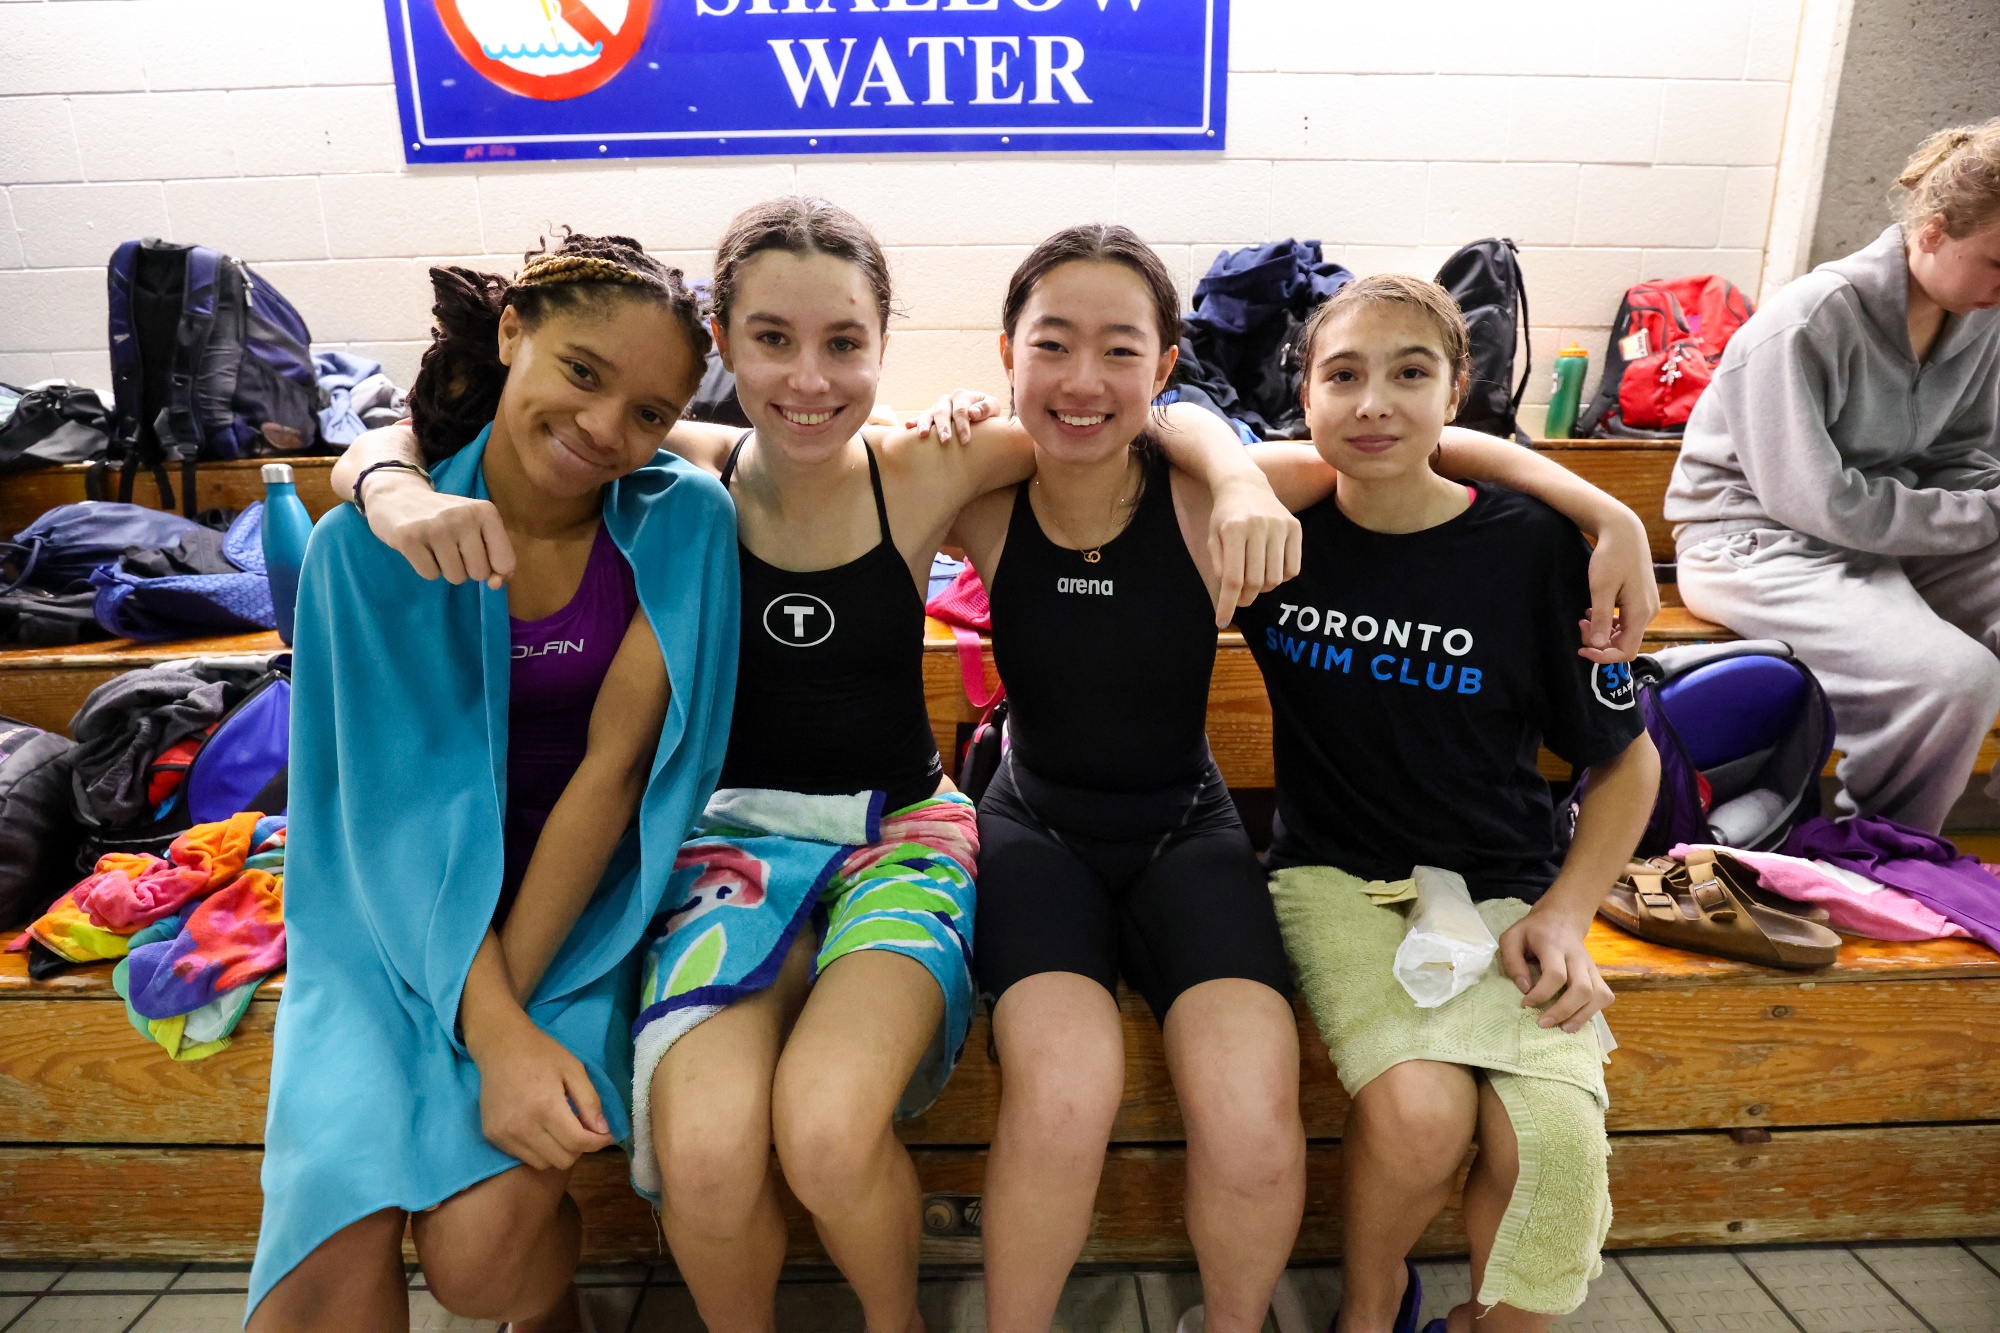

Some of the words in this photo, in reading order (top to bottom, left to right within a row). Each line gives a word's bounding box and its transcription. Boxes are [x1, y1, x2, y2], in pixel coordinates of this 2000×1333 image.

[767, 36, 1094, 109] WATER
[1057, 577, 1114, 596] arena
[783, 605, 815, 638] T
[1278, 602, 1474, 657] TORONTO
[1266, 626, 1353, 675] SWIM
[1370, 653, 1483, 695] CLUB
